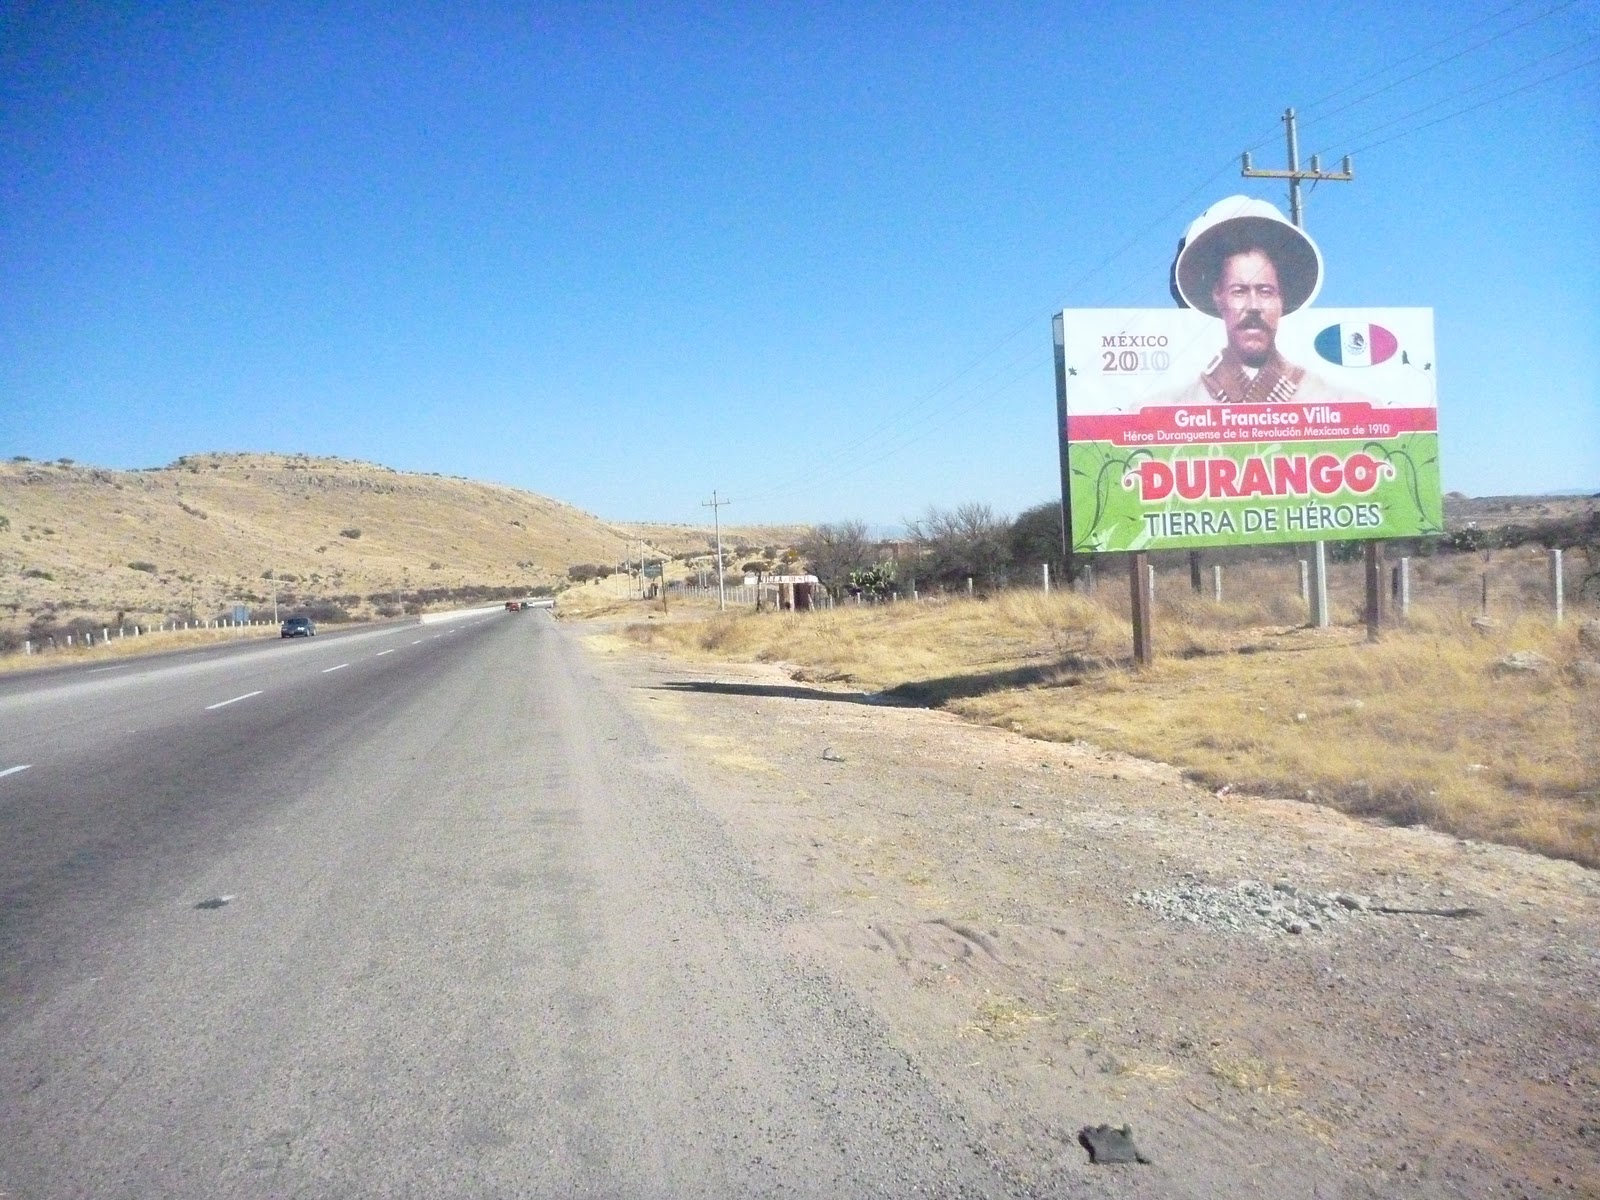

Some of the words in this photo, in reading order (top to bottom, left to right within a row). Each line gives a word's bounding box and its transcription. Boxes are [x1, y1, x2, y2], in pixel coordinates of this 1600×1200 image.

[1101, 331, 1168, 347] MÉXICO
[1102, 351, 1170, 371] 2010
[1174, 409, 1217, 427] Gral.
[1221, 407, 1299, 426] Francisco
[1302, 406, 1341, 424] Villa
[1123, 430, 1154, 442] Héroe
[1157, 430, 1220, 442] Duranguense
[1223, 428, 1237, 439] de
[1239, 428, 1249, 438] la
[1251, 426, 1301, 438] Revolución
[1303, 425, 1349, 436] Mexicana
[1352, 425, 1365, 435] de
[1367, 424, 1390, 434] 1910
[1138, 453, 1379, 501] DURANGO
[1143, 510, 1235, 537] TIERRA
[1244, 508, 1277, 532] DE
[1287, 501, 1380, 531] HÉROES
